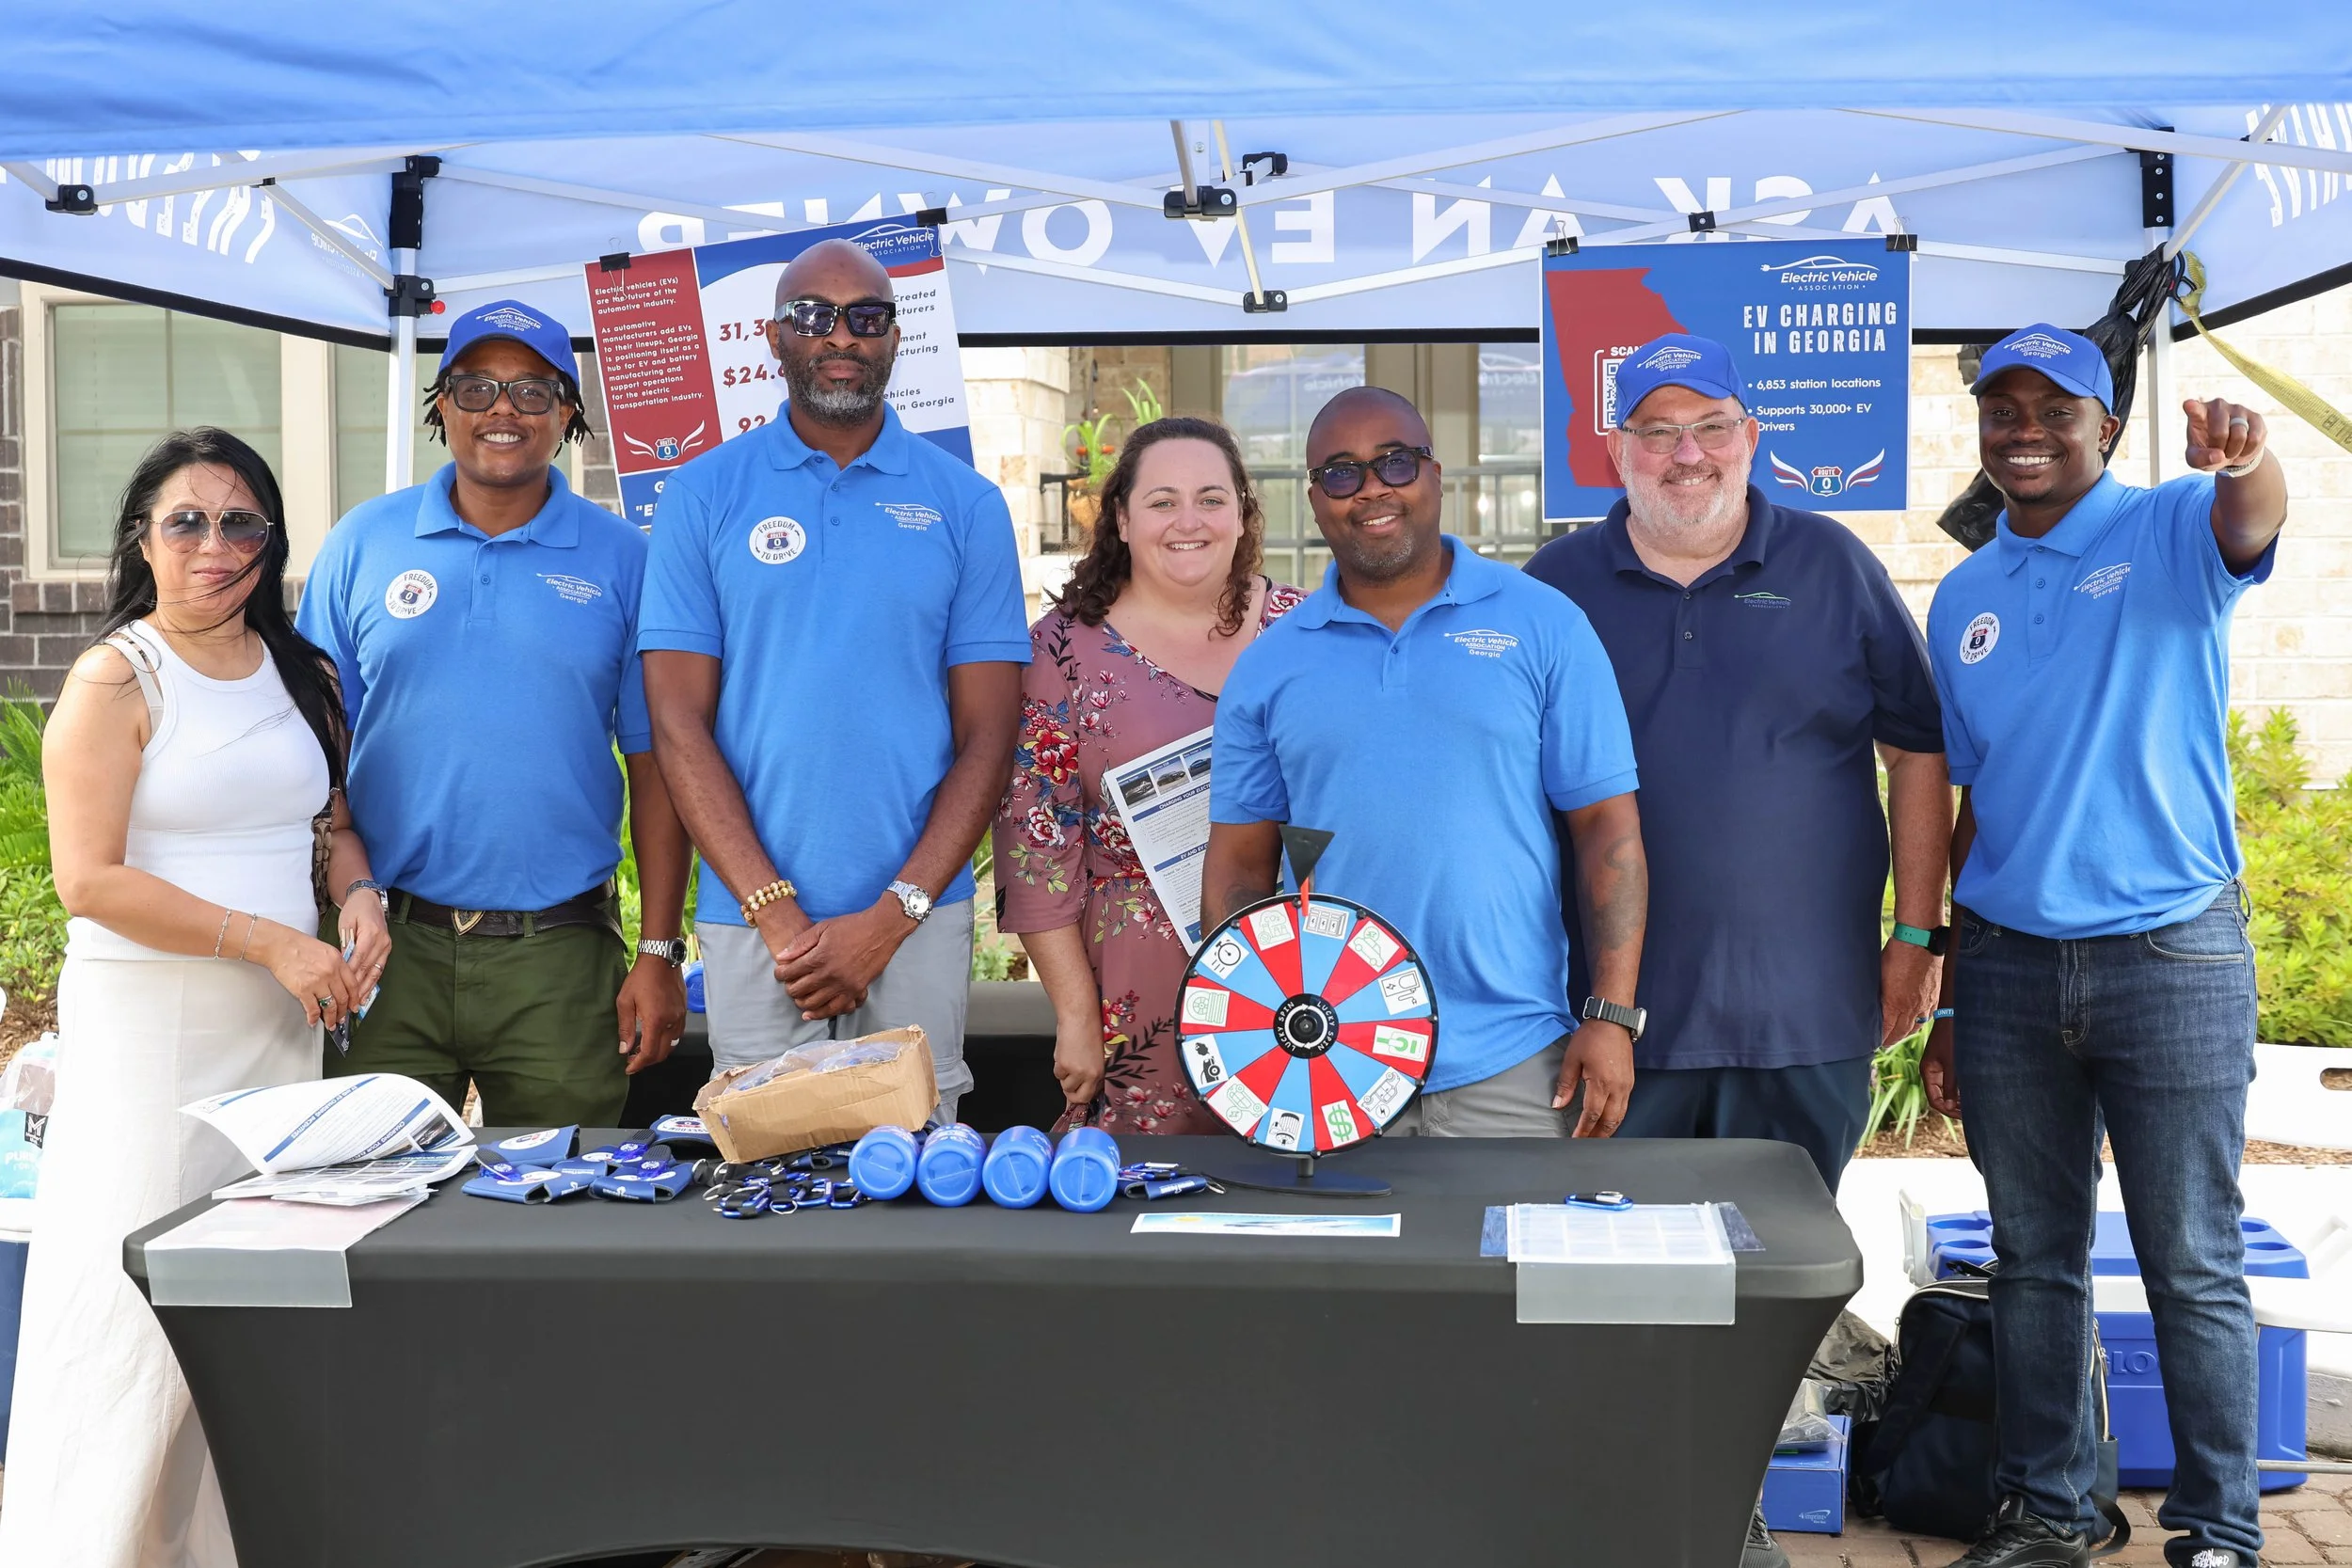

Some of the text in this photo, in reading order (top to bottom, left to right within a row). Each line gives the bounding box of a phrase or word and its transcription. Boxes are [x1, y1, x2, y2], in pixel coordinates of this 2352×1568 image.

[896, 231, 934, 245] Vehicle
[1781, 271, 1878, 283] Electric Vehicle
[595, 277, 678, 295] Electric vehicles (EVs)
[612, 294, 625, 303] the
[628, 291, 651, 300] future
[664, 287, 677, 295] the
[894, 289, 936, 302] Created
[597, 298, 676, 315] automotive industry.
[897, 304, 935, 316] cturers
[485, 313, 541, 329] Electric Vehicle
[1743, 302, 1897, 328] EV CHARGING
[613, 321, 656, 332] automotive
[719, 318, 766, 341] 31,3
[602, 330, 658, 343] manufacturers
[660, 326, 675, 335] add
[1754, 329, 1886, 354] IN GEORGIA
[615, 342, 633, 352] their
[635, 340, 665, 349] lineups,
[668, 333, 698, 344] Georgia
[2011, 340, 2070, 354] Electric Vehicle
[615, 349, 658, 362] positioning
[660, 345, 679, 354] itself
[651, 357, 666, 366] and
[669, 353, 698, 364] battery
[1645, 354, 1672, 369] Electric
[1660, 363, 1687, 372] Georgia
[609, 365, 681, 382] manufacturing and
[610, 375, 684, 392] support operations
[1756, 378, 1882, 391] 6,853 station locations
[613, 391, 705, 410] transportation industry.
[626, 390, 639, 399] the
[642, 388, 670, 396] electric
[883, 388, 921, 399] ehicles
[897, 396, 955, 411] in Georgia
[1756, 404, 1872, 417] Supports 30,000+ EV
[1757, 422, 1795, 432] Drivers
[664, 446, 672, 455] 0
[1822, 478, 1831, 489] 0
[884, 507, 942, 522] Electric Vehicle
[758, 521, 795, 533] FREEDOM
[761, 548, 797, 560] TO DRIVE
[405, 573, 434, 590] FREEDOM
[547, 578, 602, 596] Electric Vehicle
[2081, 578, 2106, 593] Electric
[560, 594, 587, 604] Georgia
[2093, 585, 2119, 599] Georgia
[1970, 617, 1994, 631] FREEDOM
[1487, 637, 1518, 647] Vehicle
[1470, 649, 1501, 657] Georgia
[1970, 646, 1988, 659] DRIVE
[1278, 1001, 1296, 1052] LUCKY SPIN
[1317, 1001, 1335, 1051] LUCKY SPIN
